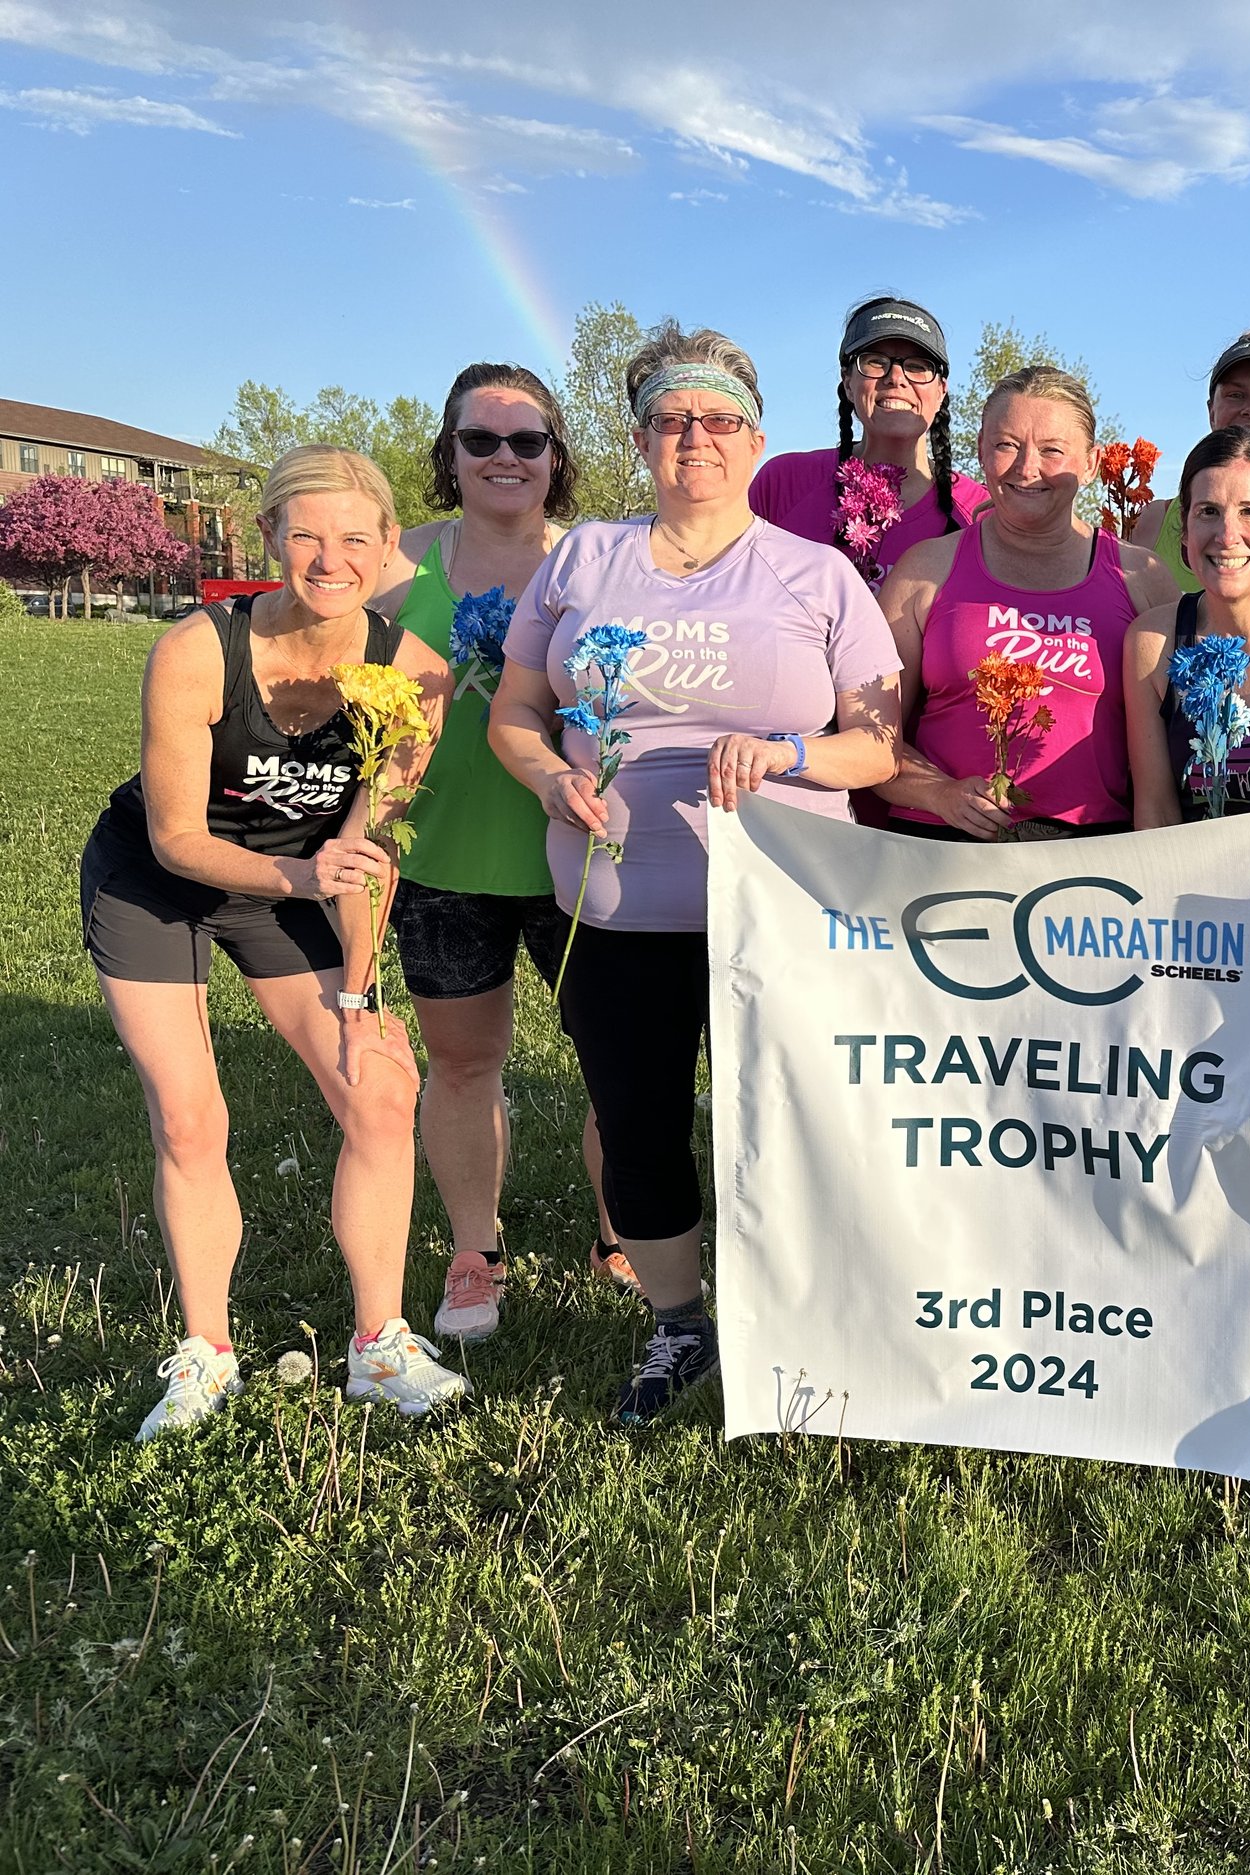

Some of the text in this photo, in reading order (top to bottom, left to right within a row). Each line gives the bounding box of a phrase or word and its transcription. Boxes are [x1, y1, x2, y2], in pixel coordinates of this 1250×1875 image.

[988, 606, 1092, 636] MOMS
[672, 647, 727, 661] on the
[986, 630, 1092, 696] Run
[1044, 637, 1088, 652] on the
[606, 643, 733, 714] Run
[247, 755, 352, 783] MOMS
[301, 783, 344, 793] on the
[241, 776, 340, 820] Run
[821, 877, 1244, 1006] THE EC MARATHON
[1150, 965, 1243, 983] SCHEELS
[835, 1035, 1225, 1104] TRAVELING
[891, 1117, 1171, 1184] TROPHY
[915, 1288, 1154, 1339] 3rd Place
[970, 1352, 1099, 1400] 2024
